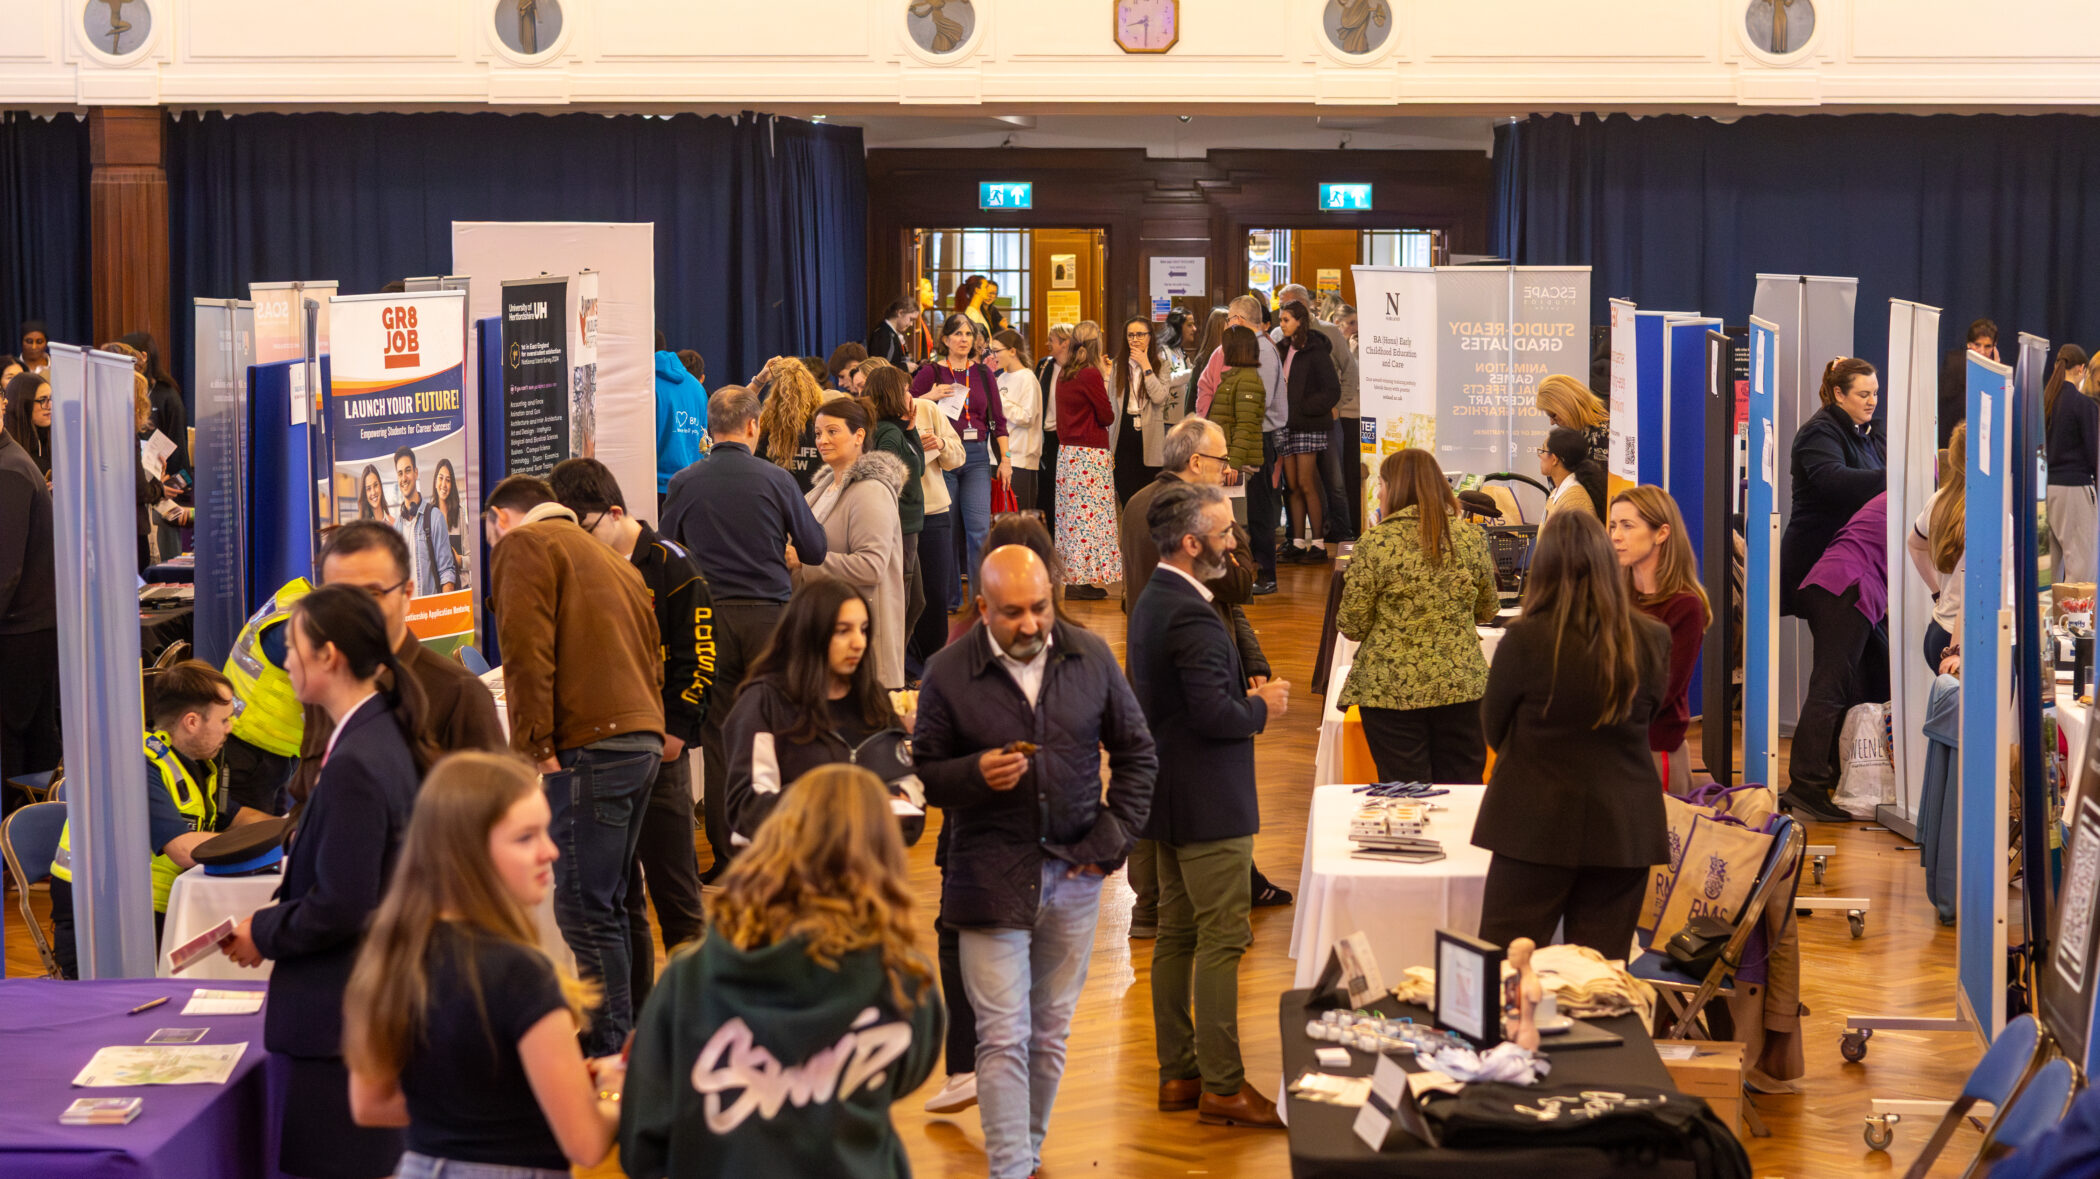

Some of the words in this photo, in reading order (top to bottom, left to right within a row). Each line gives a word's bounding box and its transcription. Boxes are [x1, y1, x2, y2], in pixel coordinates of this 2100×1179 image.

[509, 303, 527, 313] University
[533, 301, 548, 320] UH
[1385, 292, 1401, 316] N
[382, 306, 418, 330] GR8
[384, 330, 420, 354] JOB
[1373, 336, 1382, 344] BA
[1382, 336, 1399, 346] (Hons)
[1400, 337, 1412, 348] Early
[1366, 346, 1392, 356] Childhood
[1392, 348, 1417, 358] Education
[1382, 360, 1390, 368] and
[1392, 360, 1404, 368] Care
[344, 398, 387, 419] LAUNCH
[387, 396, 414, 416] YOUR
[414, 389, 460, 413] FUTURE!
[360, 427, 388, 440] Empowering
[388, 425, 407, 437] Students
[416, 423, 432, 434] Career
[432, 420, 452, 432] Success!
[1361, 421, 1376, 432] TEF
[1361, 432, 1376, 440] 2023
[1483, 515, 1506, 527] MS
[404, 612, 428, 622] enticeship
[428, 607, 453, 619] Application
[453, 604, 470, 614] Mentoring
